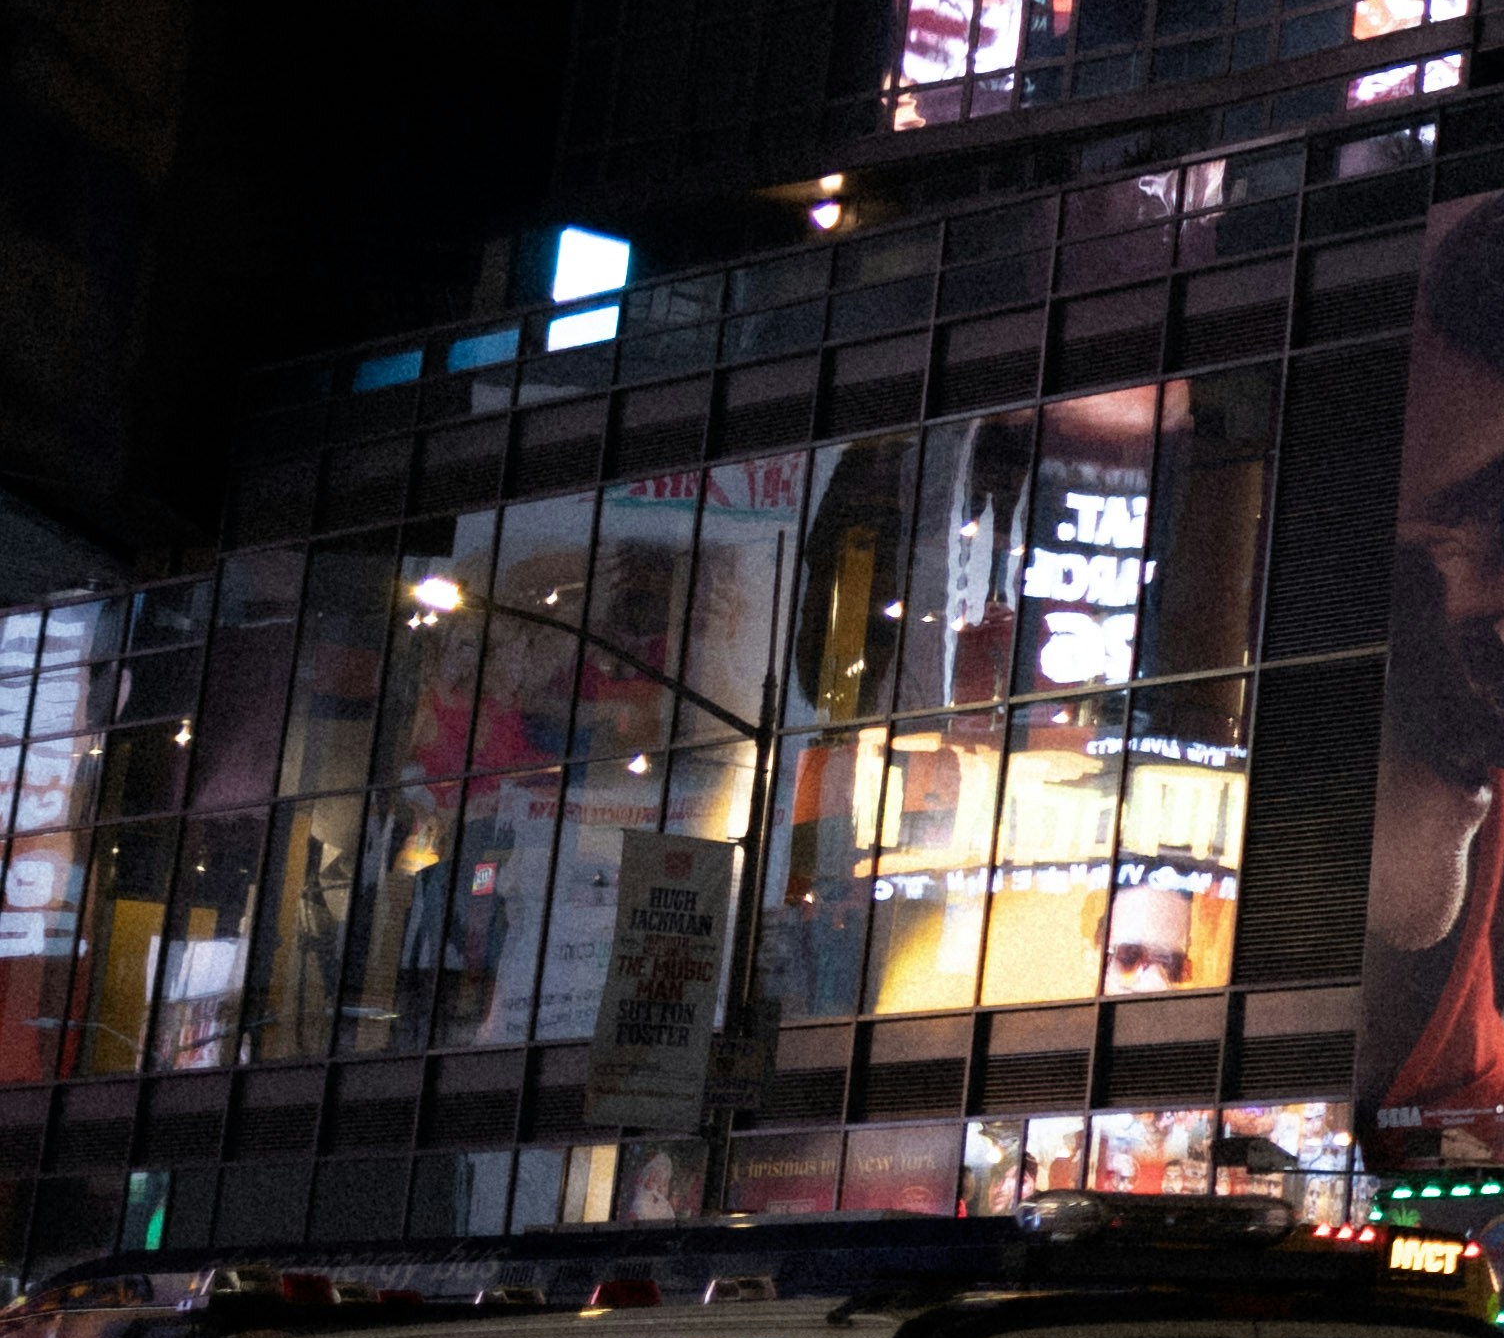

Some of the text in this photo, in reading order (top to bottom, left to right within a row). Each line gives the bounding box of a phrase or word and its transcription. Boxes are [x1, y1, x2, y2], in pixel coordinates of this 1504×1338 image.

[650, 886, 697, 912] HUGH
[629, 908, 713, 937] JACKMAN
[618, 956, 713, 983] THE MUSIC
[636, 981, 684, 1002] MAN
[617, 999, 697, 1025] SUTTON
[616, 1023, 690, 1048] FOSTER
